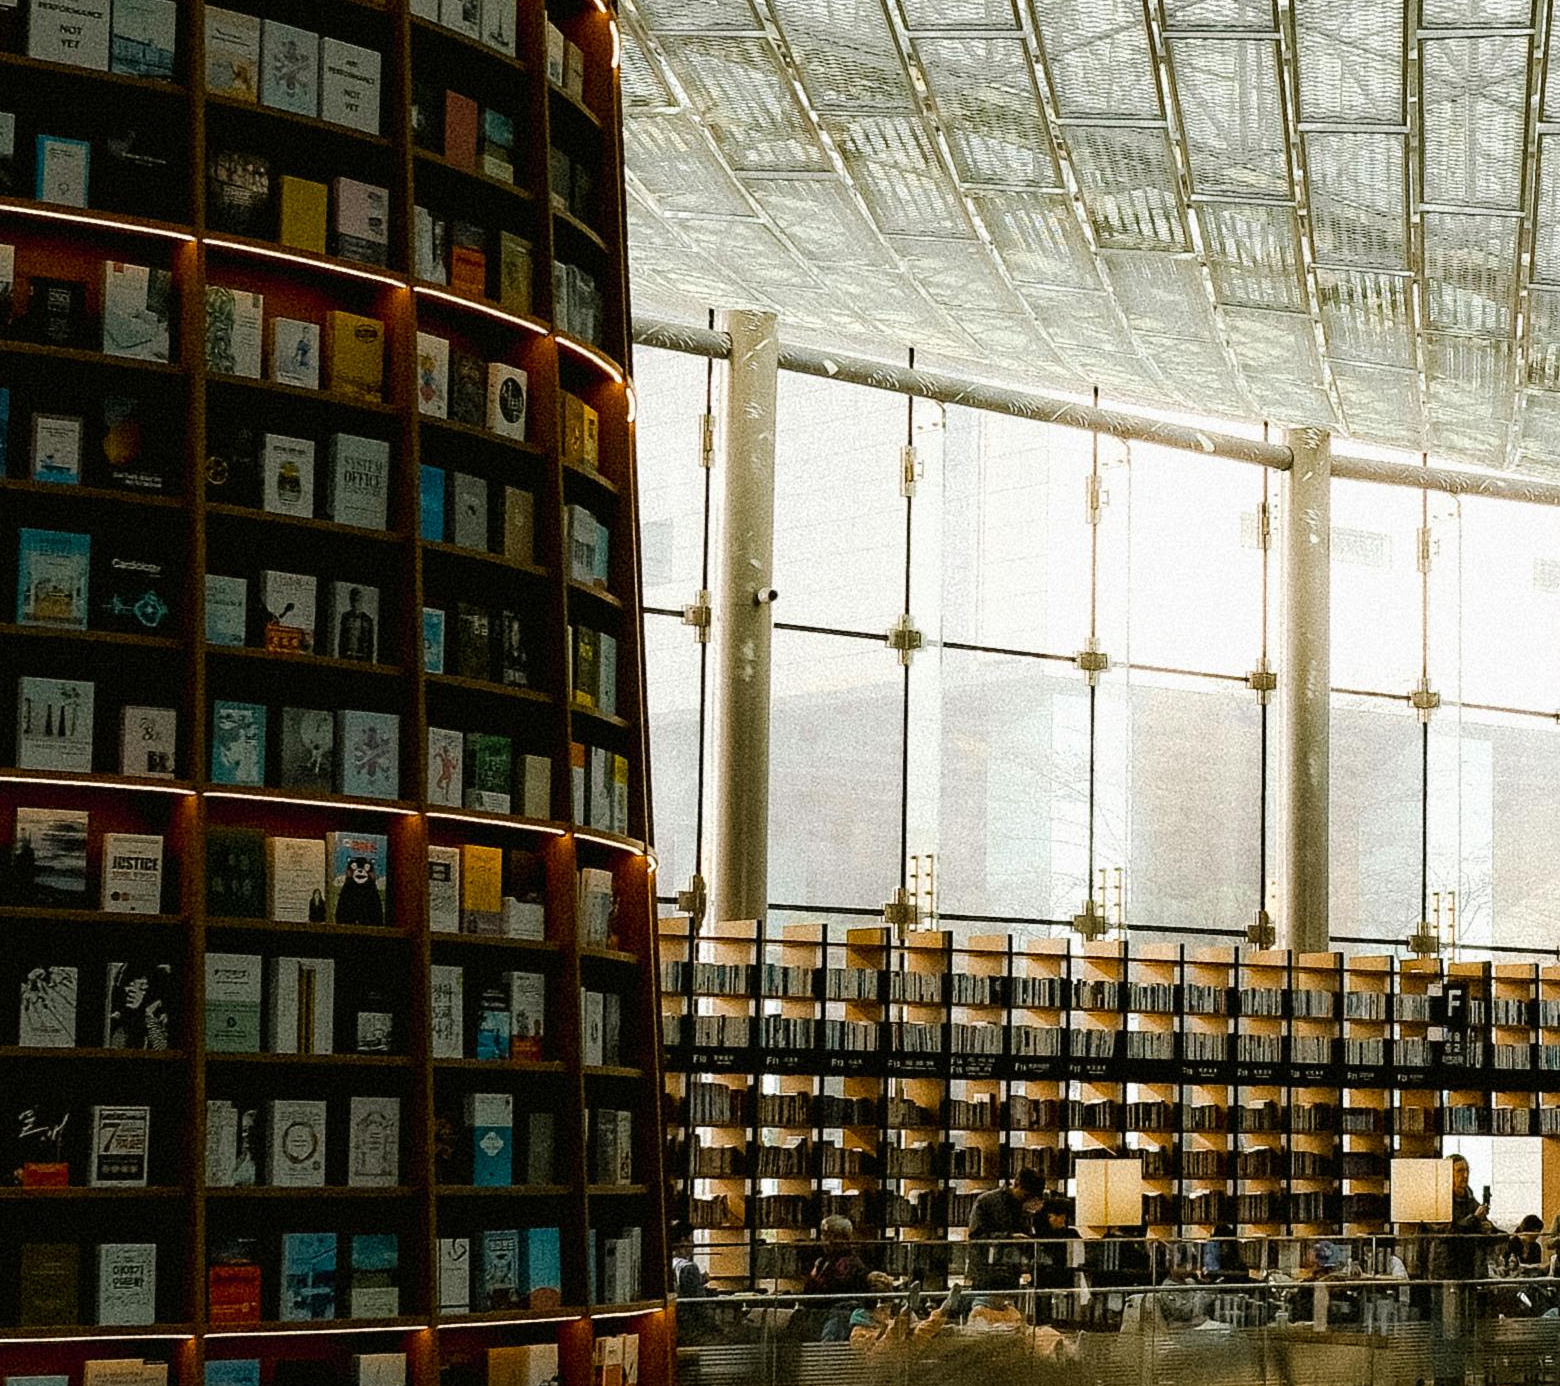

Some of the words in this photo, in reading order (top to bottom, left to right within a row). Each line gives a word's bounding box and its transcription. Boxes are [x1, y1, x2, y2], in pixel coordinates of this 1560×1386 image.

[59, 24, 82, 36] NOT
[344, 470, 380, 487] OFFICE
[1448, 989, 1462, 1017] F
